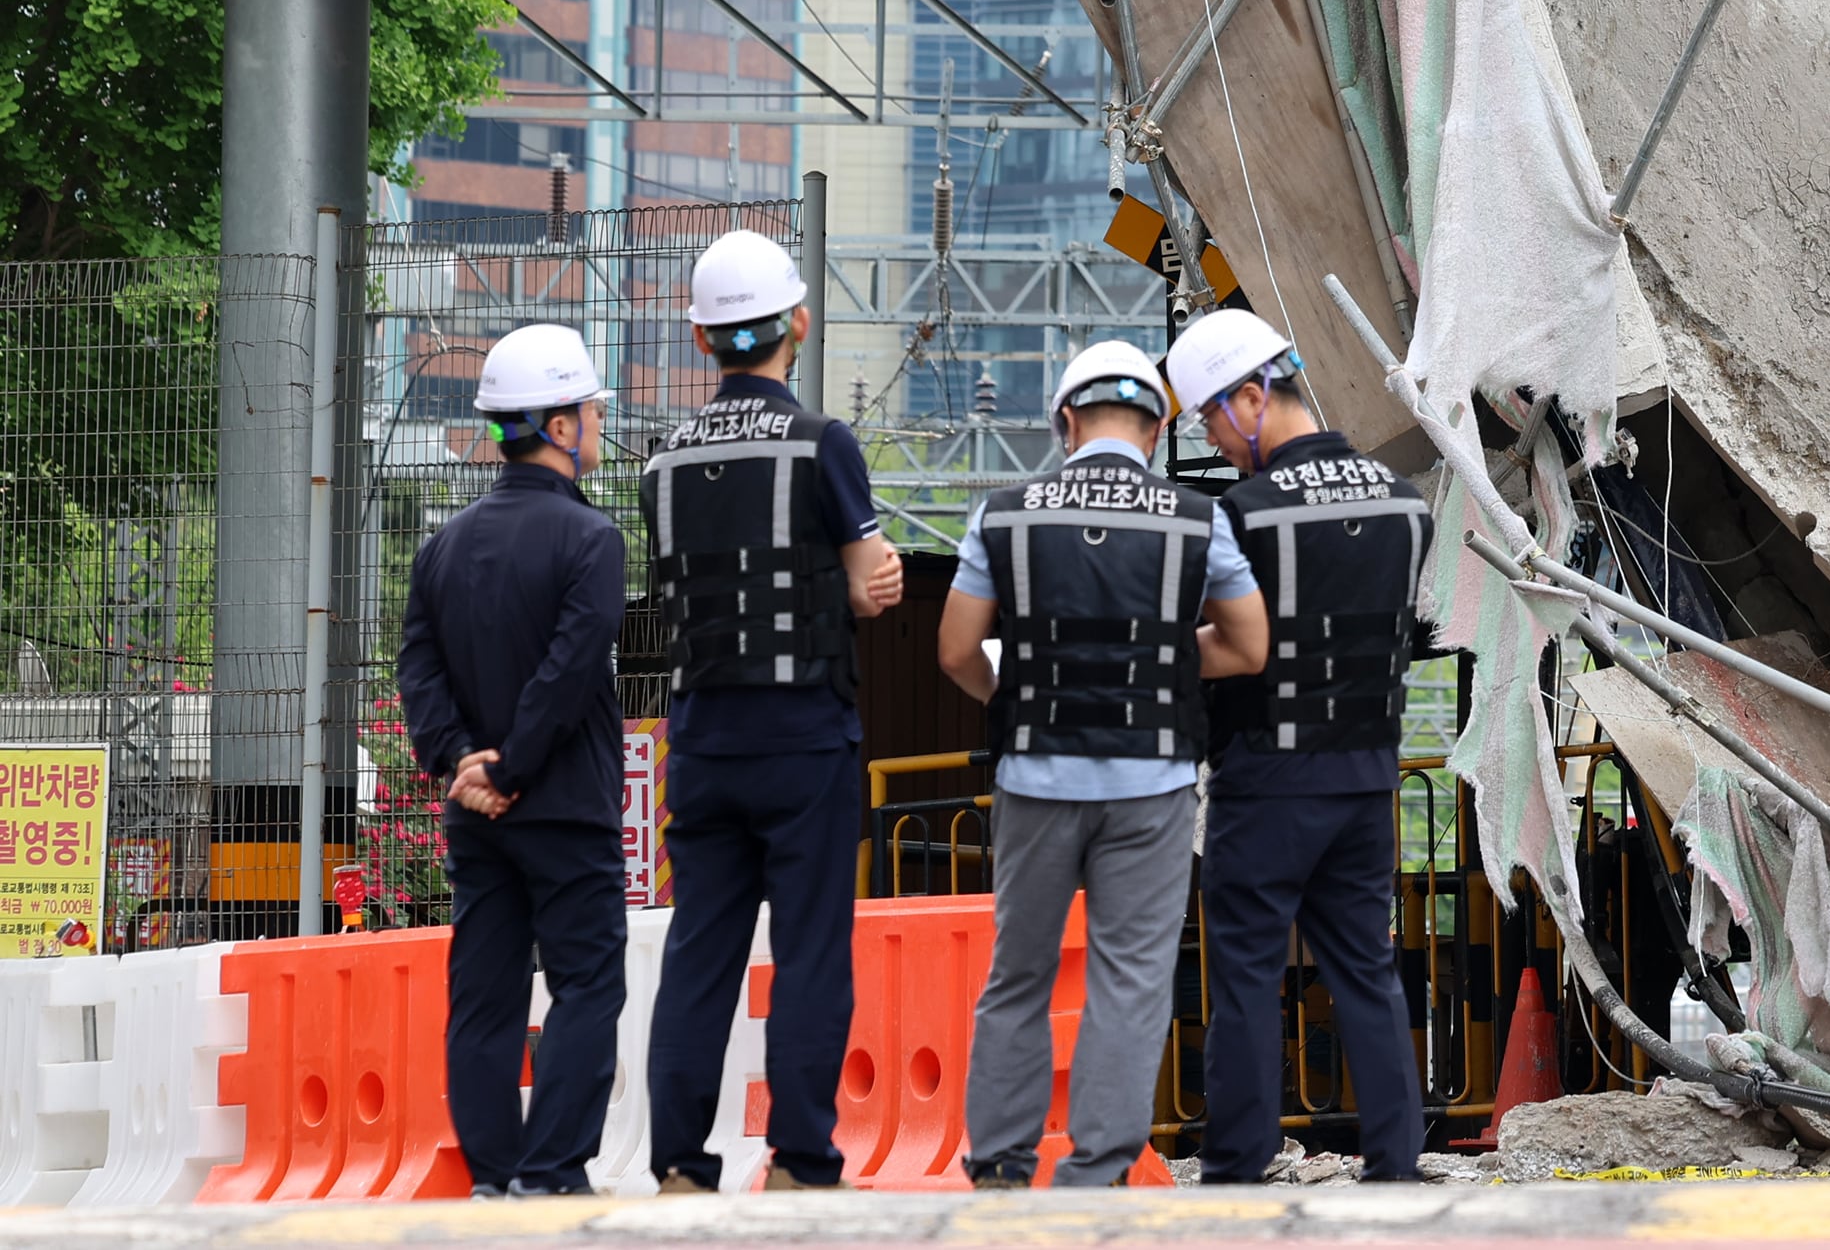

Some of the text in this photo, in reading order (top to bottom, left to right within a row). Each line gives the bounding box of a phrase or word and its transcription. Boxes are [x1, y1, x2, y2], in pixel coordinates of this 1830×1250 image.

[1270, 458, 1396, 491] 안전보건공단
[1023, 481, 1179, 517] 중앙사고조사단
[44, 899, 93, 915] 70,000원
